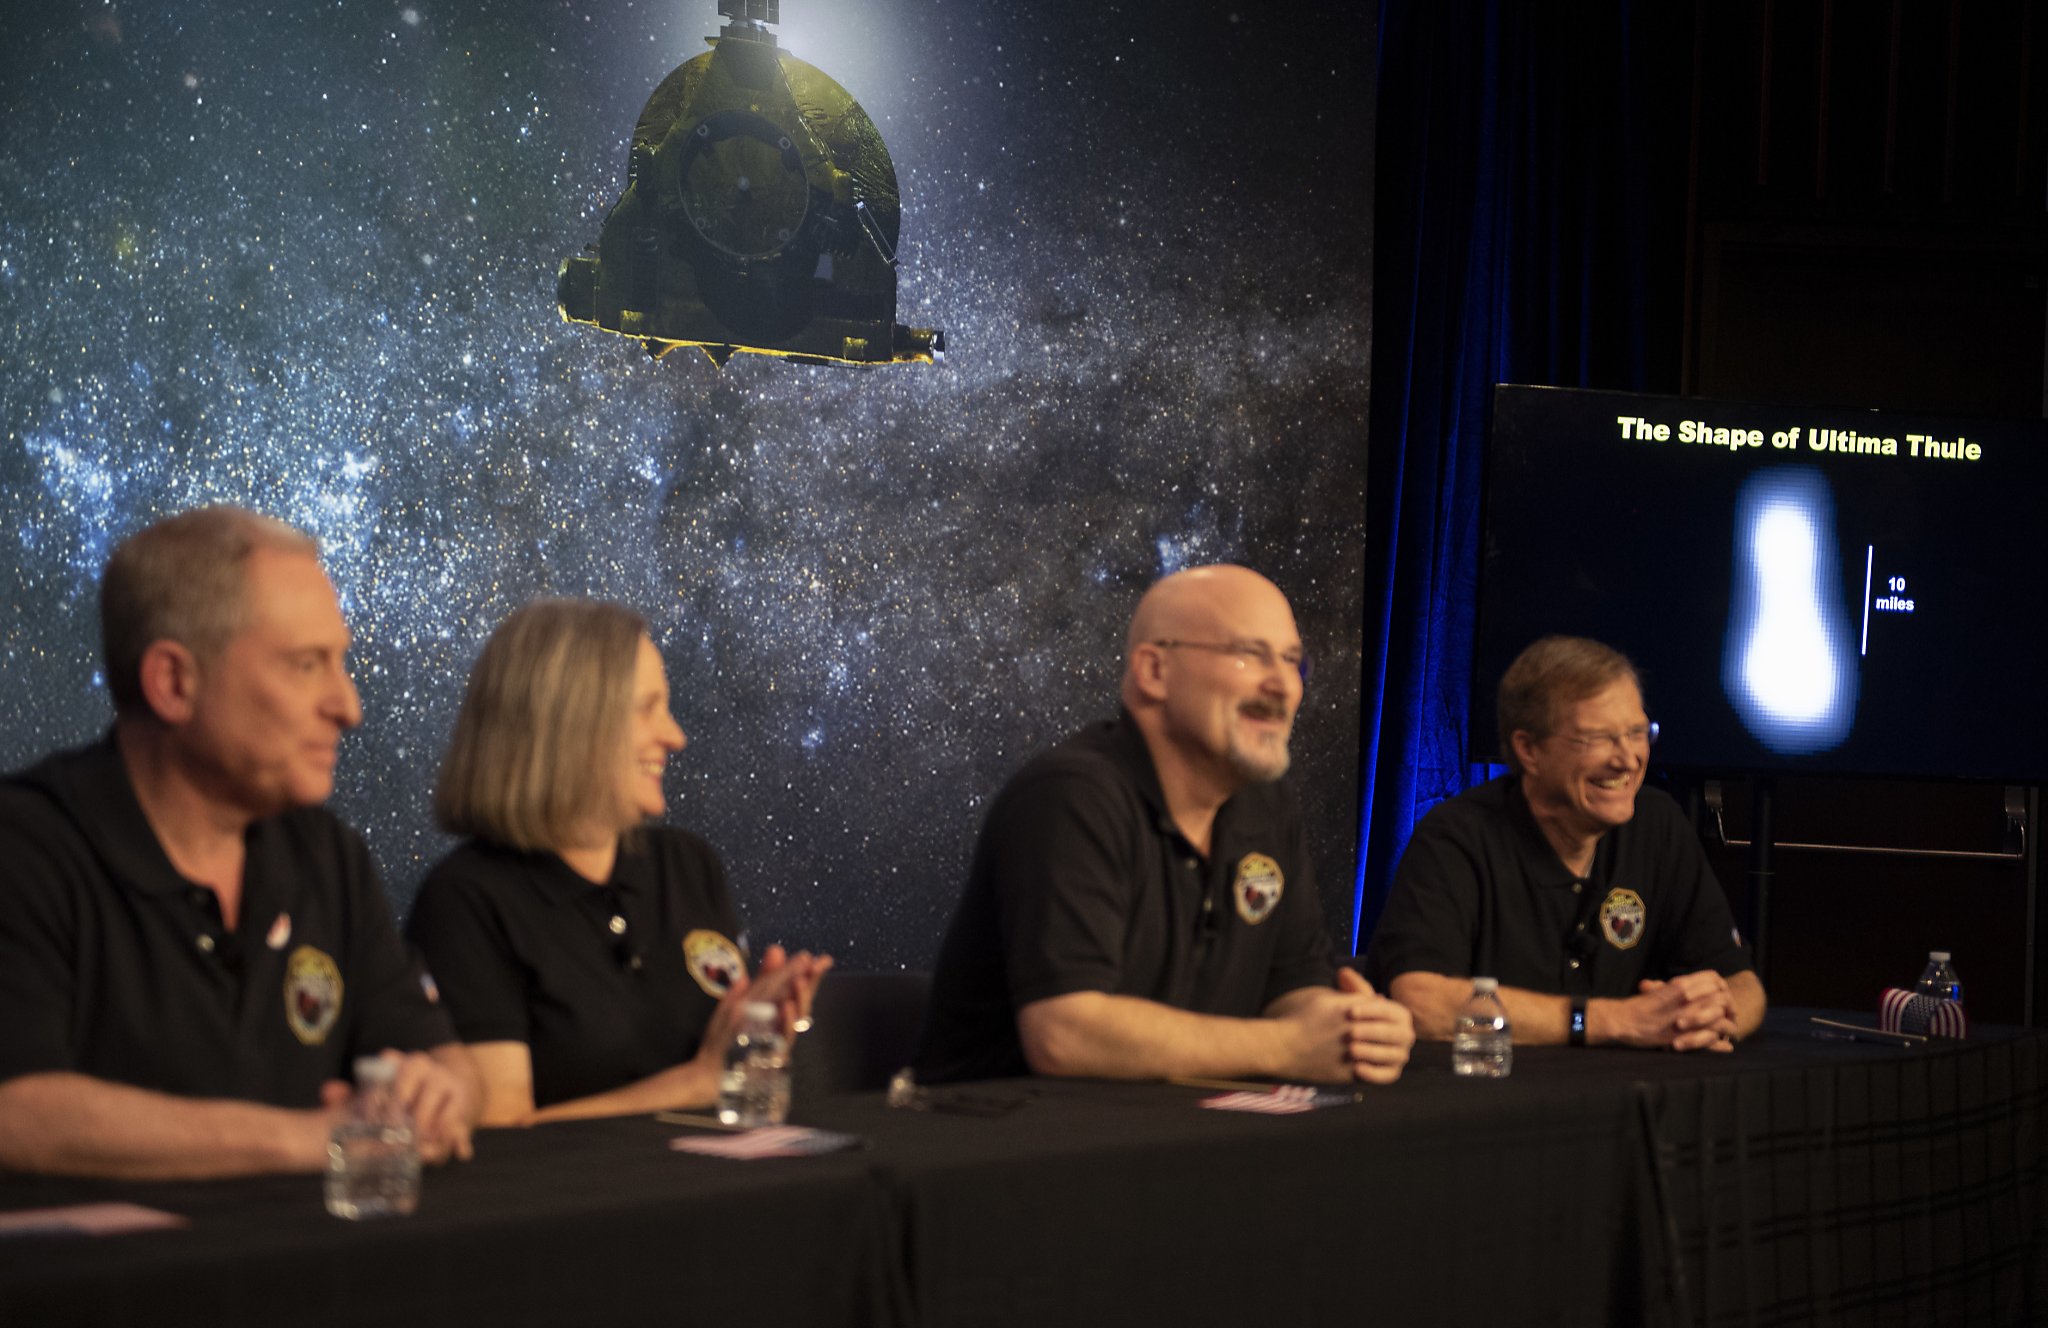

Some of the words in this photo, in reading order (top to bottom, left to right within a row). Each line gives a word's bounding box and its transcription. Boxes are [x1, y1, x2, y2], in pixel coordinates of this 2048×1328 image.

[1617, 416, 1671, 442] The
[1677, 420, 1765, 452] Shape
[1771, 426, 1801, 450] of
[1808, 428, 1898, 456] Ultima
[1905, 434, 1982, 461] Thule
[1887, 575, 1906, 594] 10
[1875, 594, 1915, 614] miles
